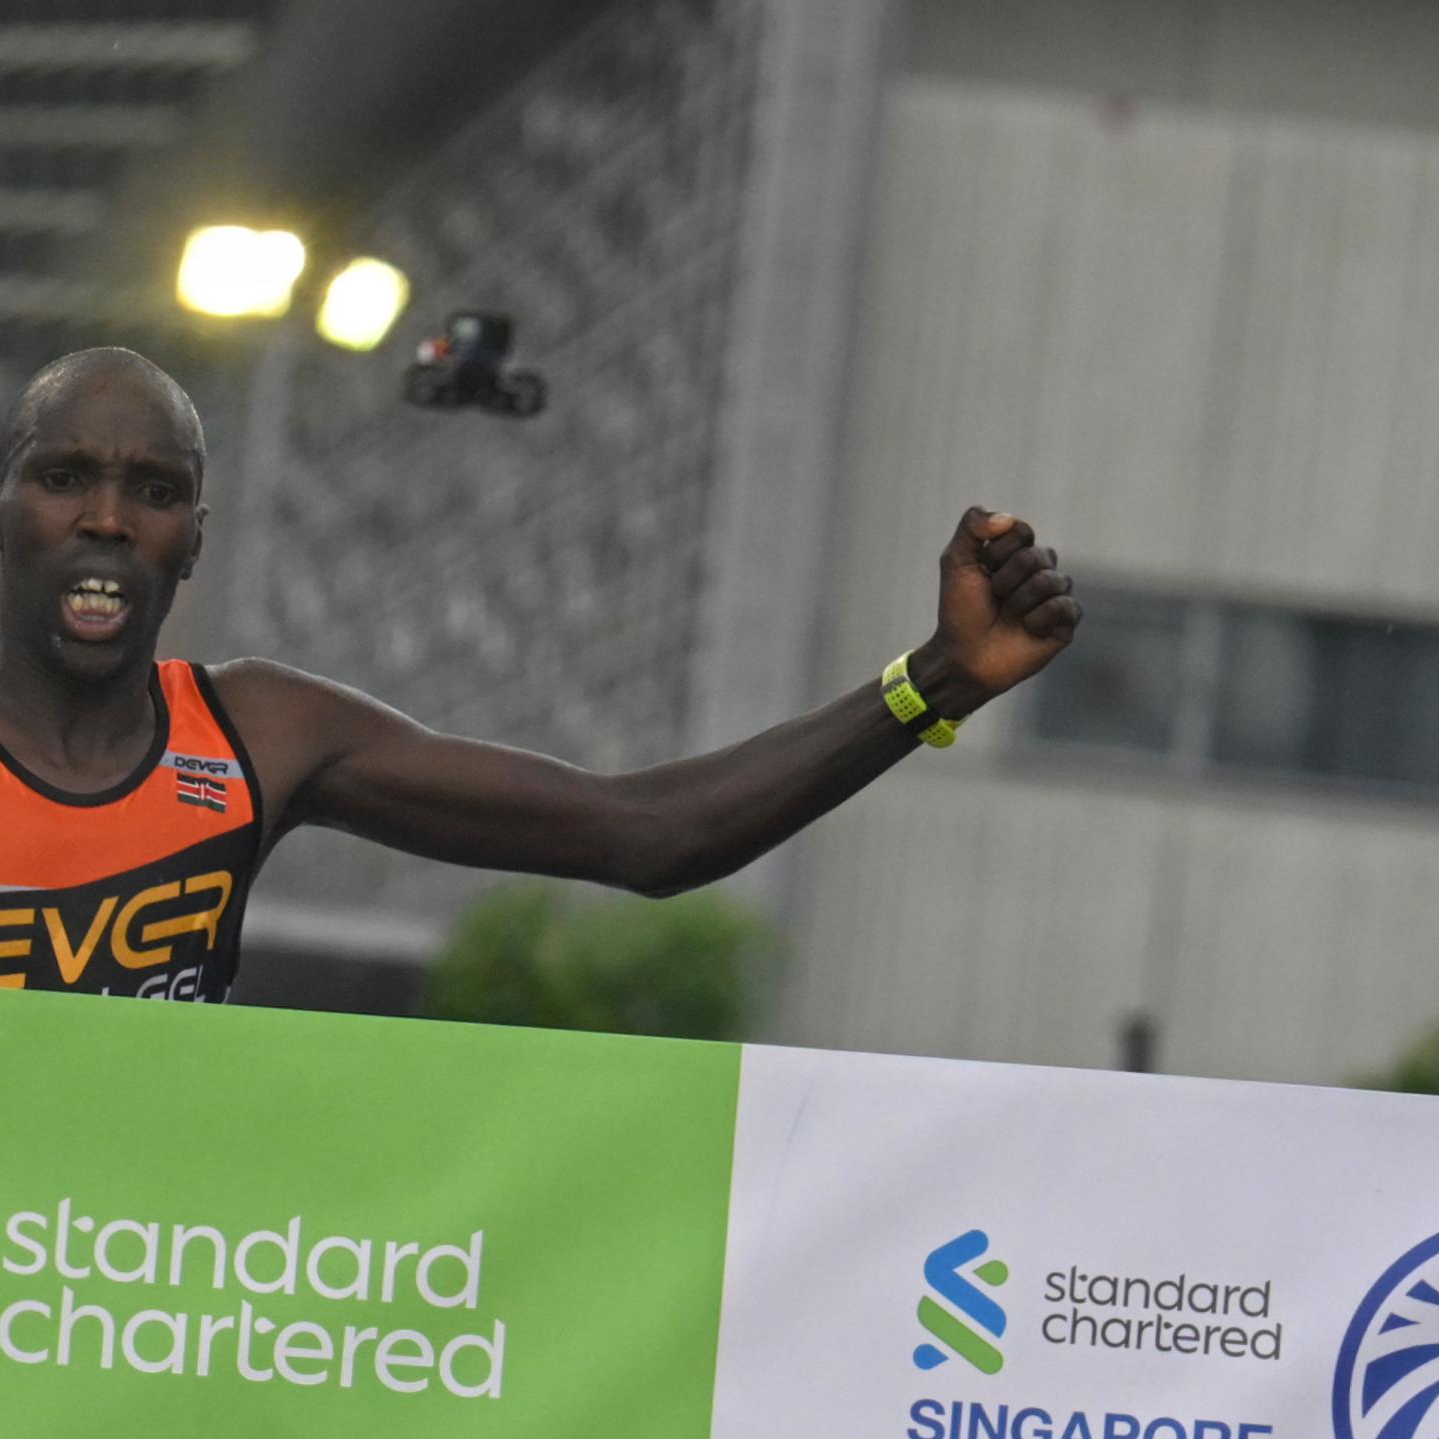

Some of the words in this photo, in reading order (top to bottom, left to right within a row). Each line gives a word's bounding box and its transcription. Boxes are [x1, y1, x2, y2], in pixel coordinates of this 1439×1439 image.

[1, 1196, 484, 1310] standard
[1043, 1264, 1272, 1319] standard
[1040, 1306, 1283, 1361] chartered
